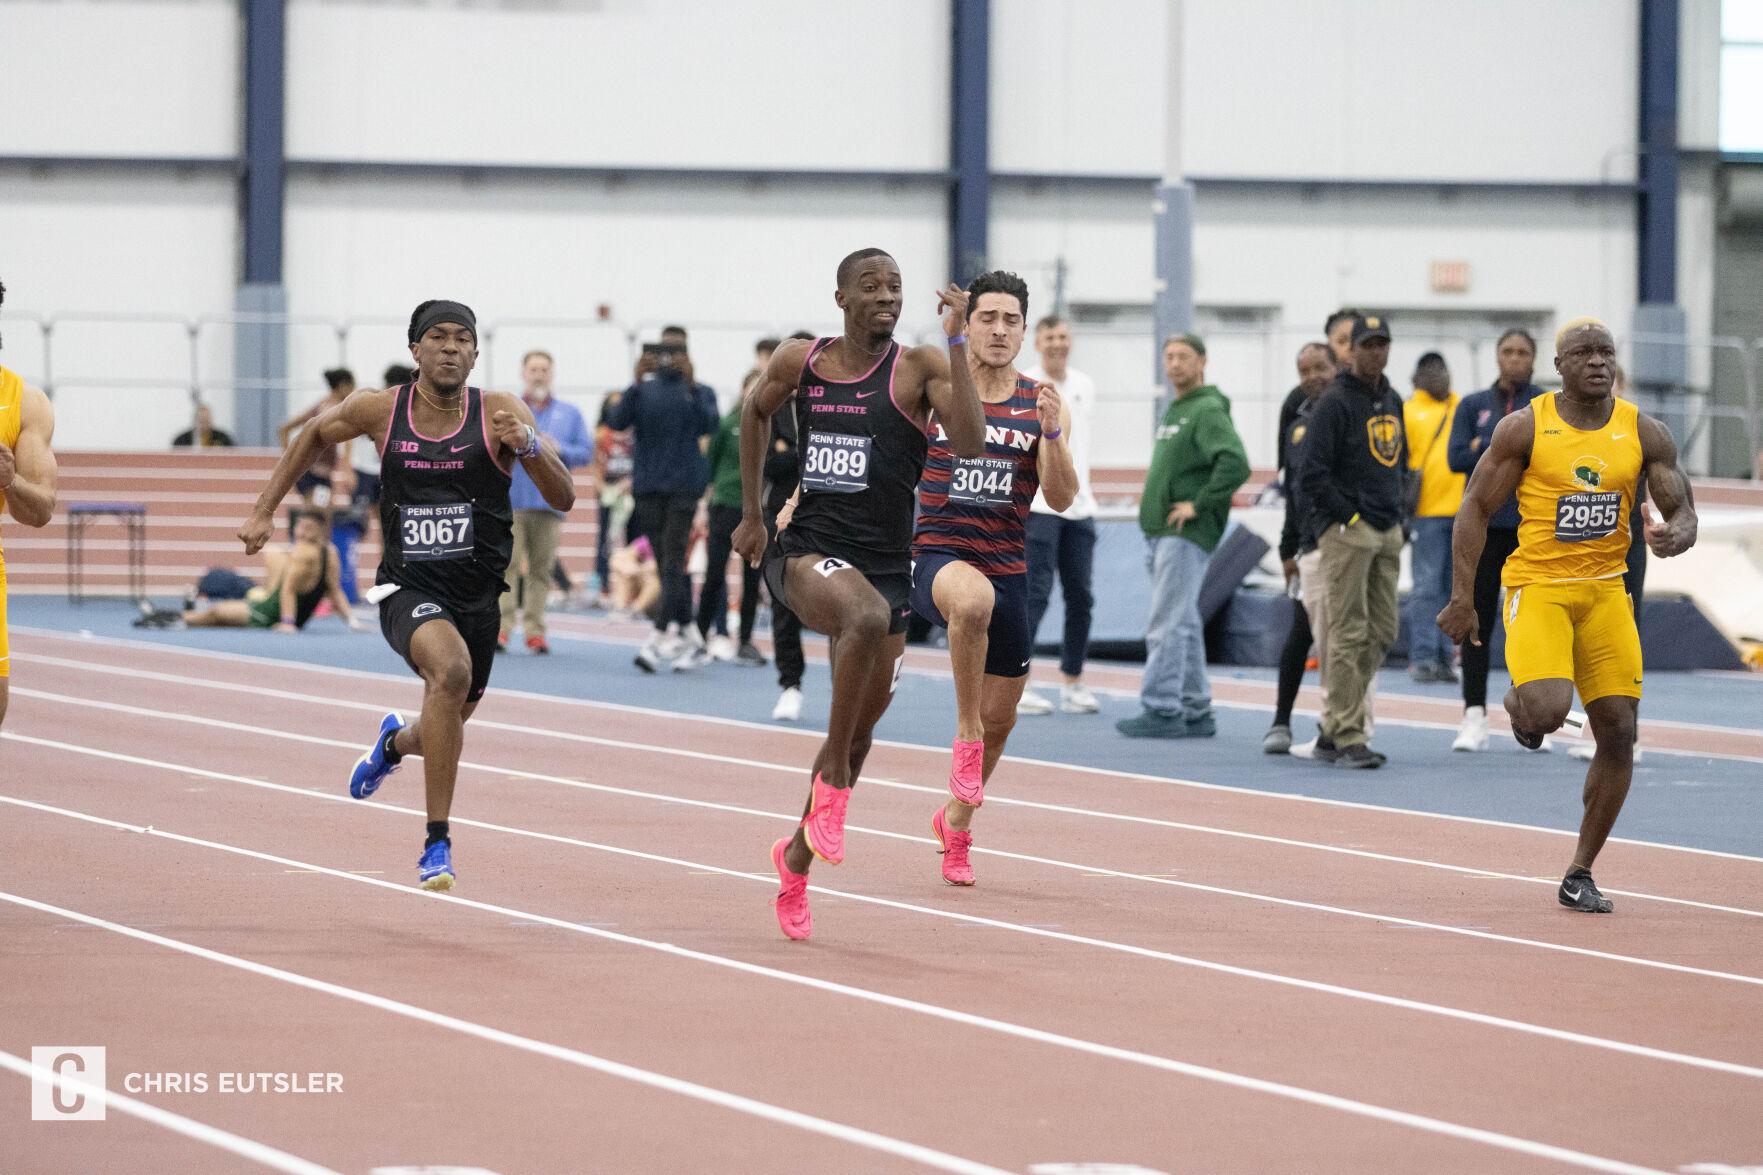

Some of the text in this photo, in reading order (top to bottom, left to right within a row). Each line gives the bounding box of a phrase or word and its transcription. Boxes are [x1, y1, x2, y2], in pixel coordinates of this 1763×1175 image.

[811, 404, 868, 415] PENN STATE
[810, 434, 865, 448] PENN STATE
[405, 460, 465, 469] PENN STATE
[805, 446, 867, 478] 3089
[959, 458, 1013, 470] PENN STATE
[952, 467, 1013, 496] 3044
[1565, 494, 1617, 503] PENN STATE
[407, 505, 465, 516] PENN STATE
[1559, 504, 1618, 529] 2955
[403, 517, 470, 546] 3067
